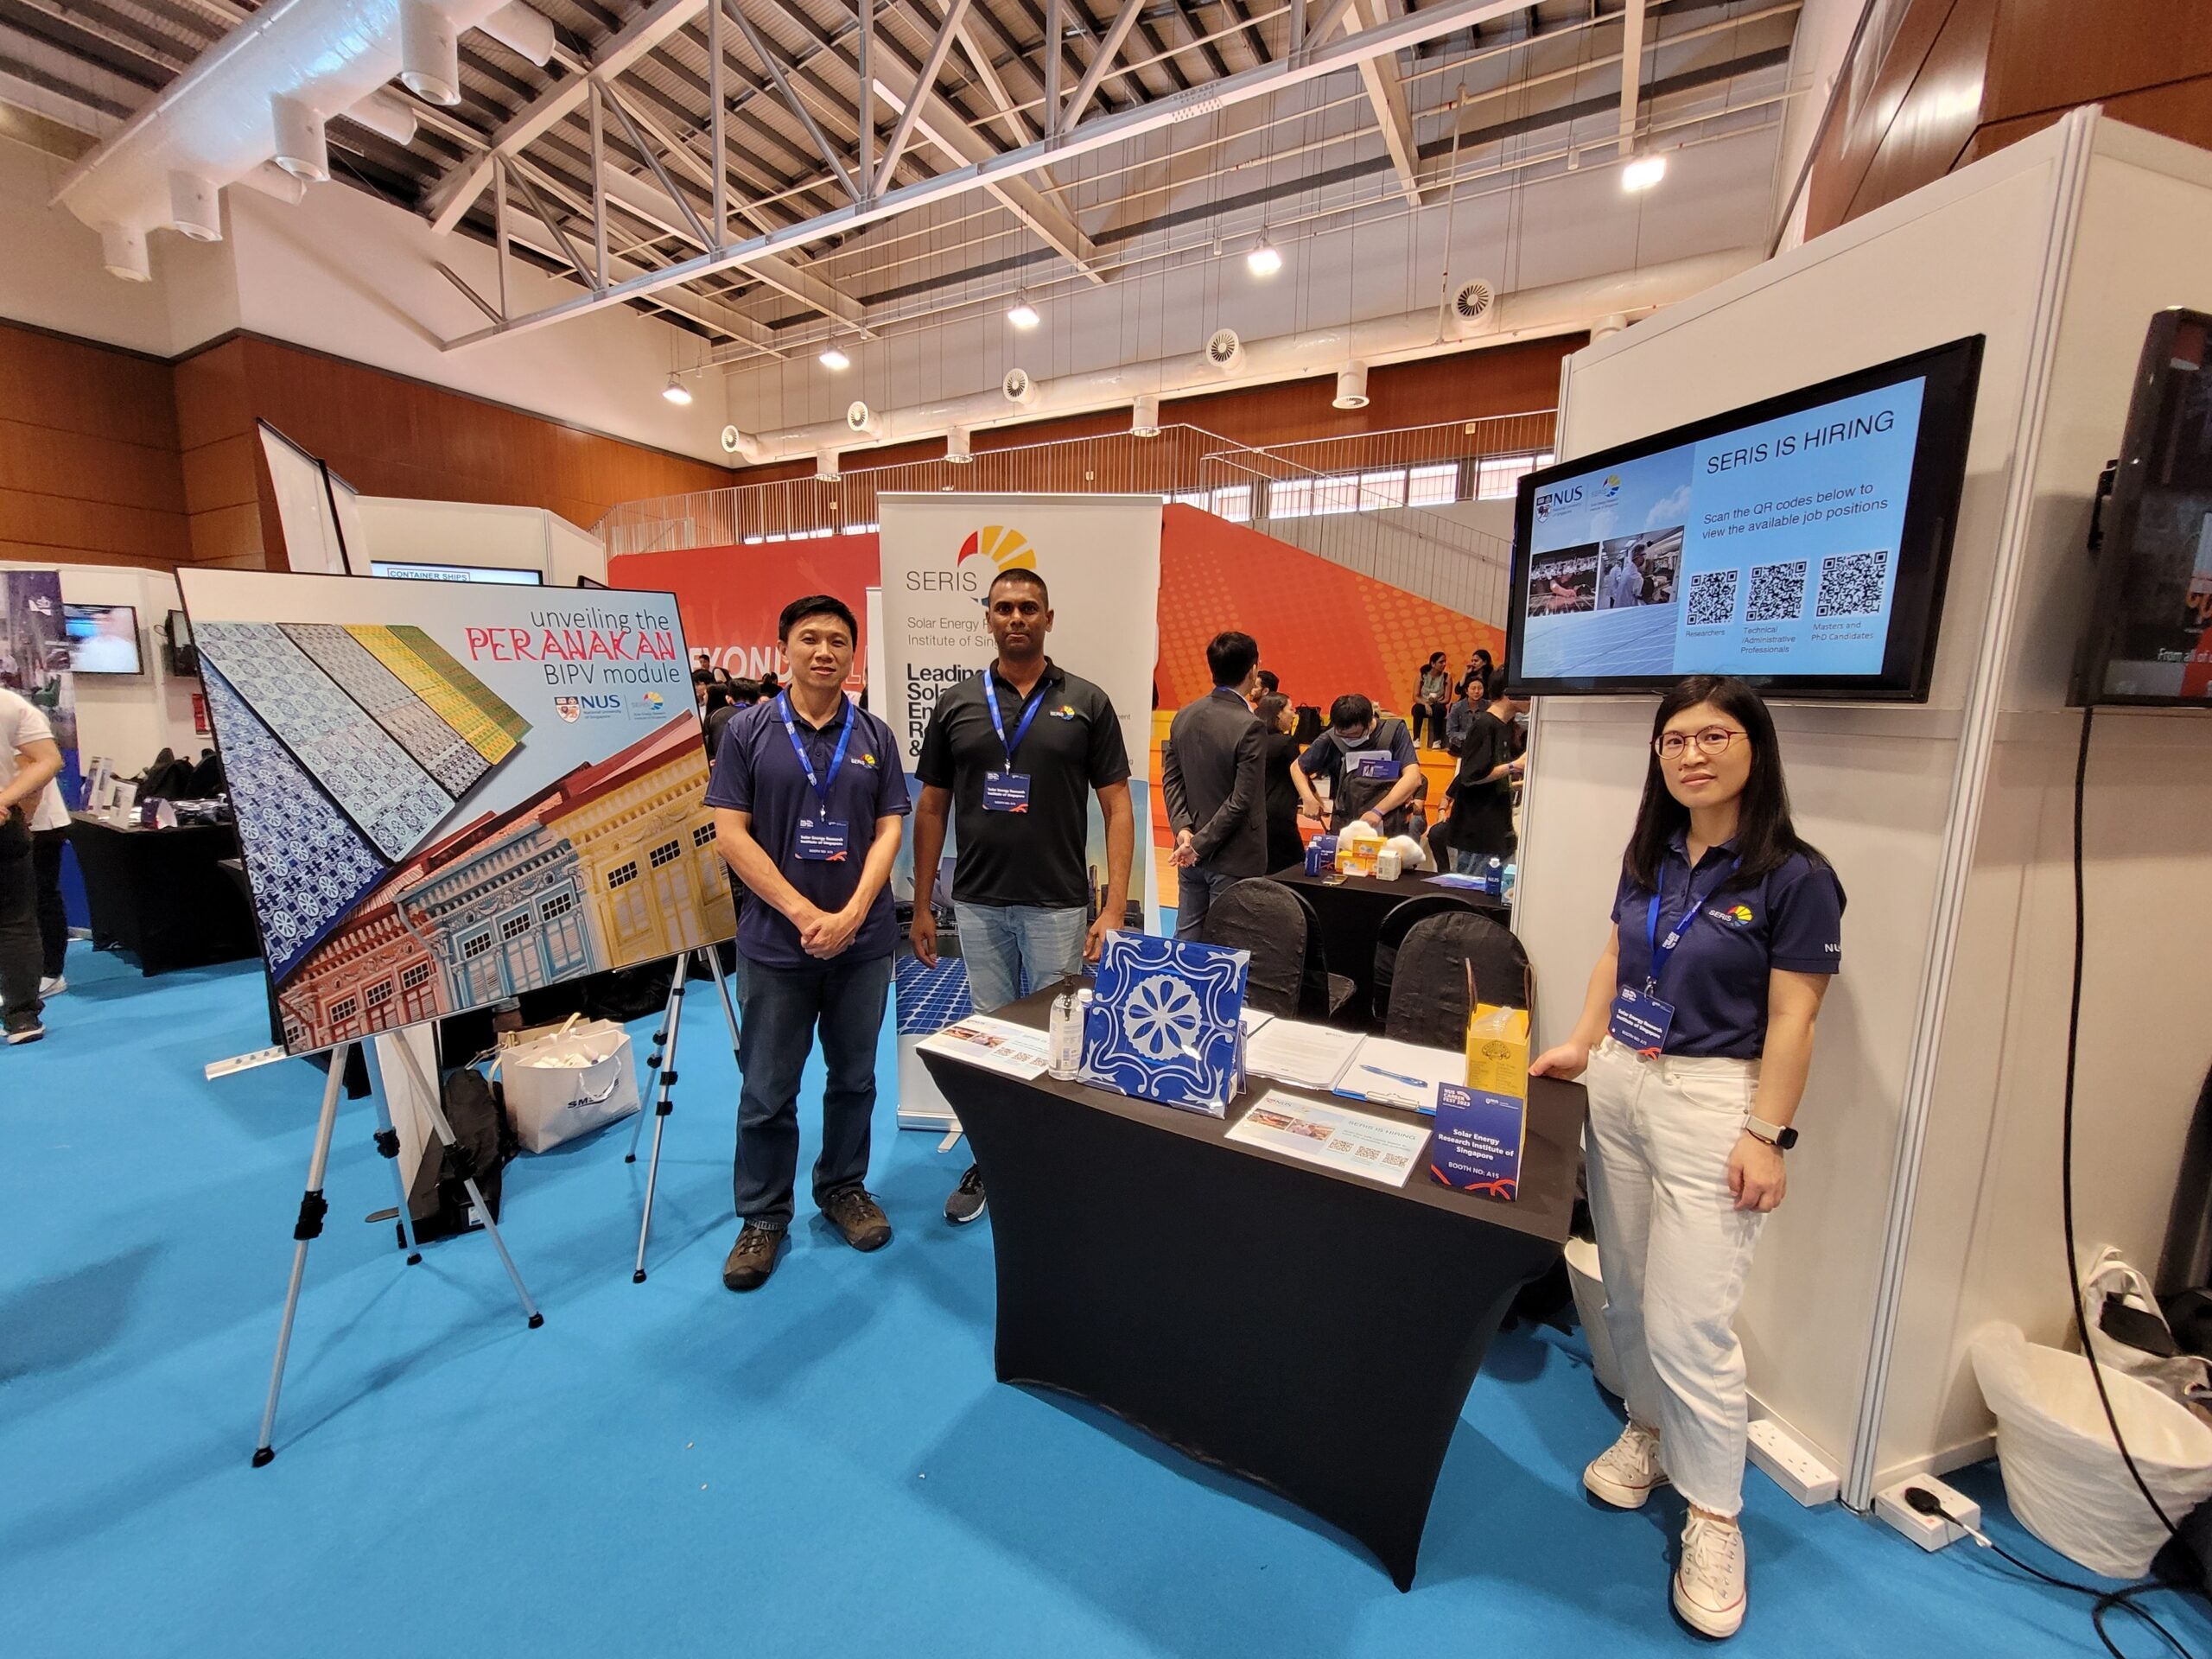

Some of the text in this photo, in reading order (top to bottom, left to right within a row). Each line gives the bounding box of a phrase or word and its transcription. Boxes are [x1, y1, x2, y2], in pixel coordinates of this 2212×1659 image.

[1707, 410, 1894, 474] SERIS IS HIRING
[1554, 486, 1583, 506] NUS
[1704, 484, 1873, 524] Scan the QR codes below to
[1702, 499, 1889, 539] view the available job positions
[390, 570, 467, 582] CONTAINER SHIPS
[906, 571, 977, 592] SERIS
[531, 607, 670, 634] unveiling the
[907, 617, 936, 629] Solar
[940, 618, 979, 632] Energy
[1813, 622, 1844, 631] Masters
[1686, 629, 1726, 638] Researchers
[1743, 626, 1778, 635] Technical
[1811, 632, 1874, 641] PhD Candidates
[465, 627, 676, 661] PERANAKAN
[908, 634, 955, 646] Institute
[959, 636, 970, 647] of
[1741, 635, 1796, 645] /Administrative
[2158, 648, 2183, 661] From
[543, 662, 680, 685] BIPV module
[907, 663, 988, 683] Leadin
[581, 695, 620, 709] NUS
[1708, 909, 1732, 922] SERIS
[1349, 1120, 1374, 1130] SERIS
[1384, 1128, 1417, 1141] HIRING
[1453, 1128, 1500, 1146] Solar Energy
[1438, 1134, 1470, 1147] Research
[1471, 1141, 1503, 1154] Institute
[1456, 1147, 1494, 1160] Singapore
[1448, 1161, 1500, 1179] BOOTH NO: A15
